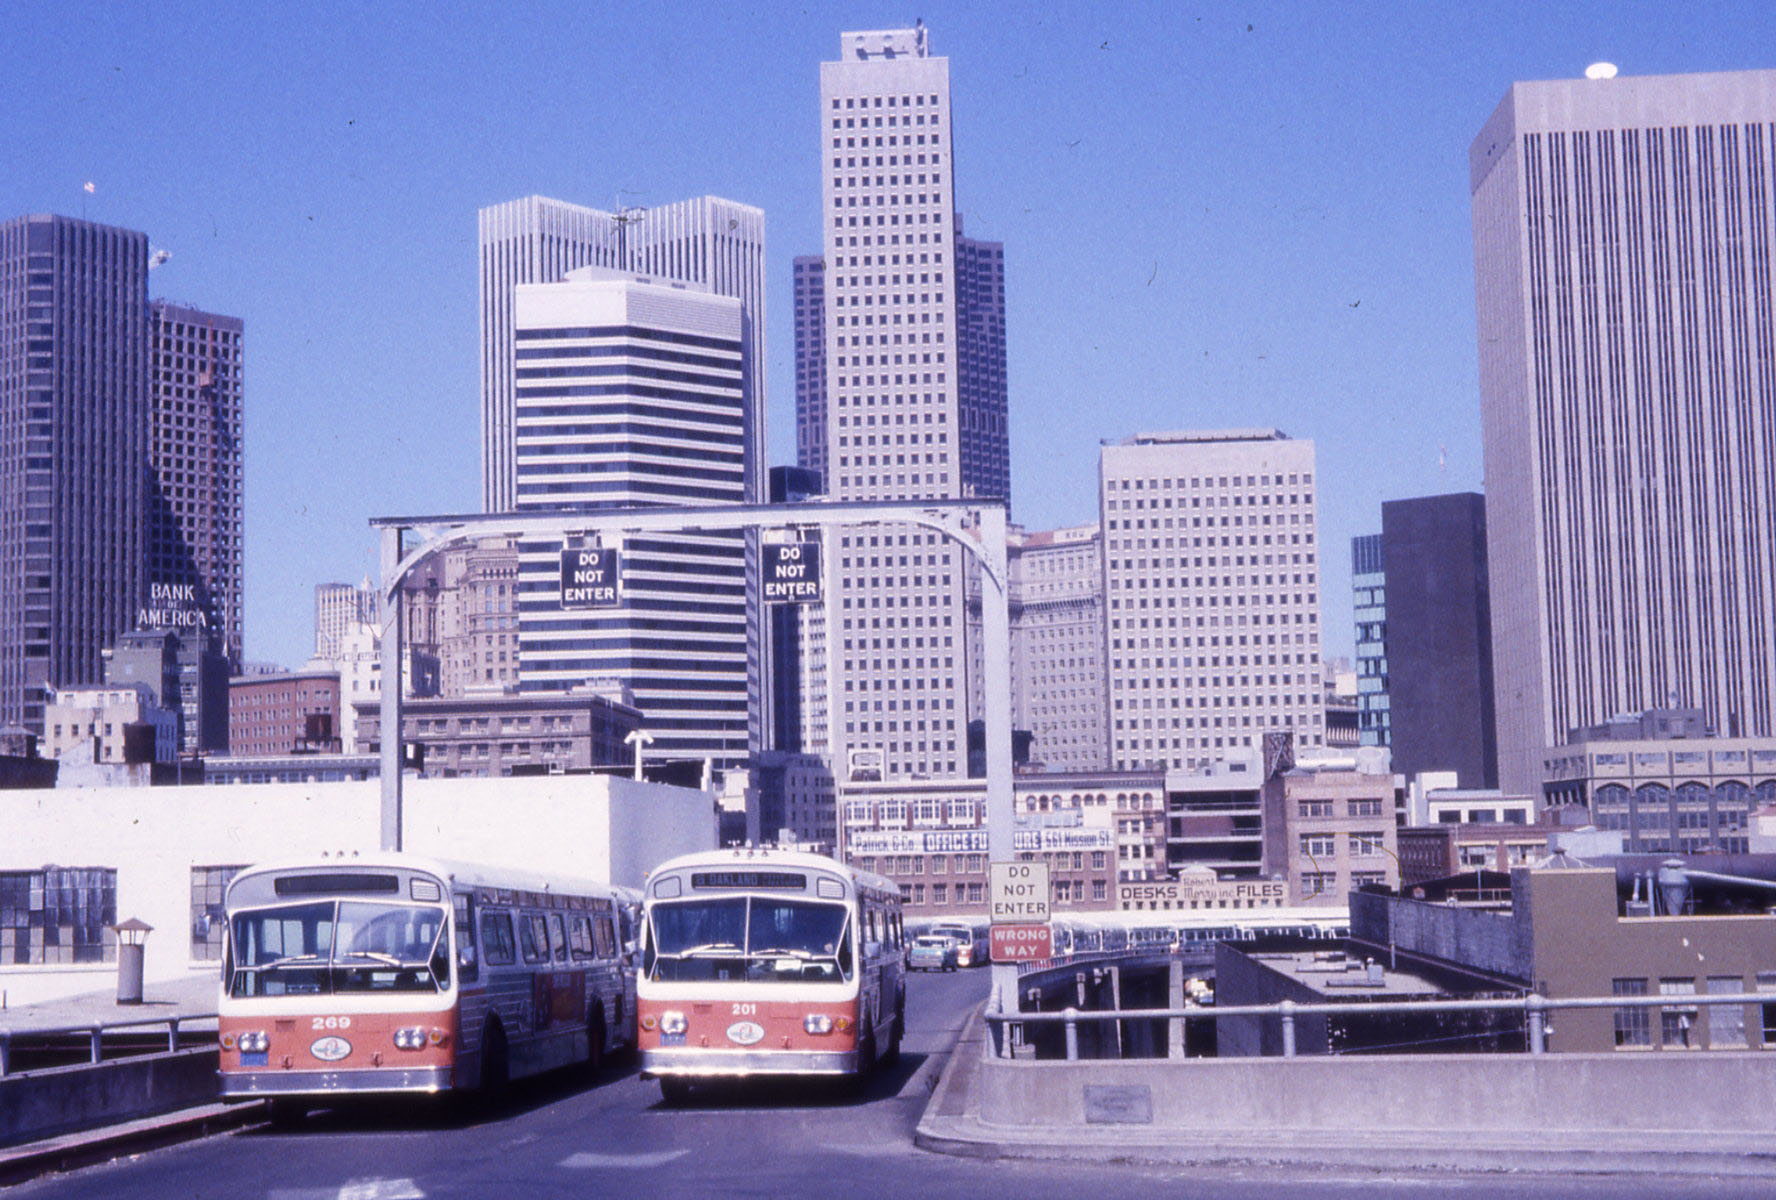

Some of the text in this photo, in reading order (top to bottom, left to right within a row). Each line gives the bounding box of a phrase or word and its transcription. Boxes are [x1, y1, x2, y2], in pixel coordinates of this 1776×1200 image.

[579, 553, 599, 566] DO
[780, 547, 800, 560] DO
[574, 570, 604, 583] NOT
[775, 565, 806, 578] NOT
[151, 582, 195, 601] BANK
[565, 587, 614, 600] ENTER
[766, 582, 817, 595] ENTER
[138, 609, 207, 627] AMERICA
[856, 835, 889, 852] Patrick
[926, 831, 1041, 851] OFFICE FUURE
[1064, 830, 1097, 848] Mission
[1009, 866, 1030, 878] DO
[1004, 884, 1035, 896] NOT
[1121, 886, 1178, 899] DESKS
[1236, 884, 1283, 897] FILES
[995, 902, 1046, 914] ENTER
[994, 930, 1047, 941] WRONG
[1004, 946, 1037, 956] WAY
[732, 1003, 757, 1015] 201
[311, 1016, 351, 1030] 269
